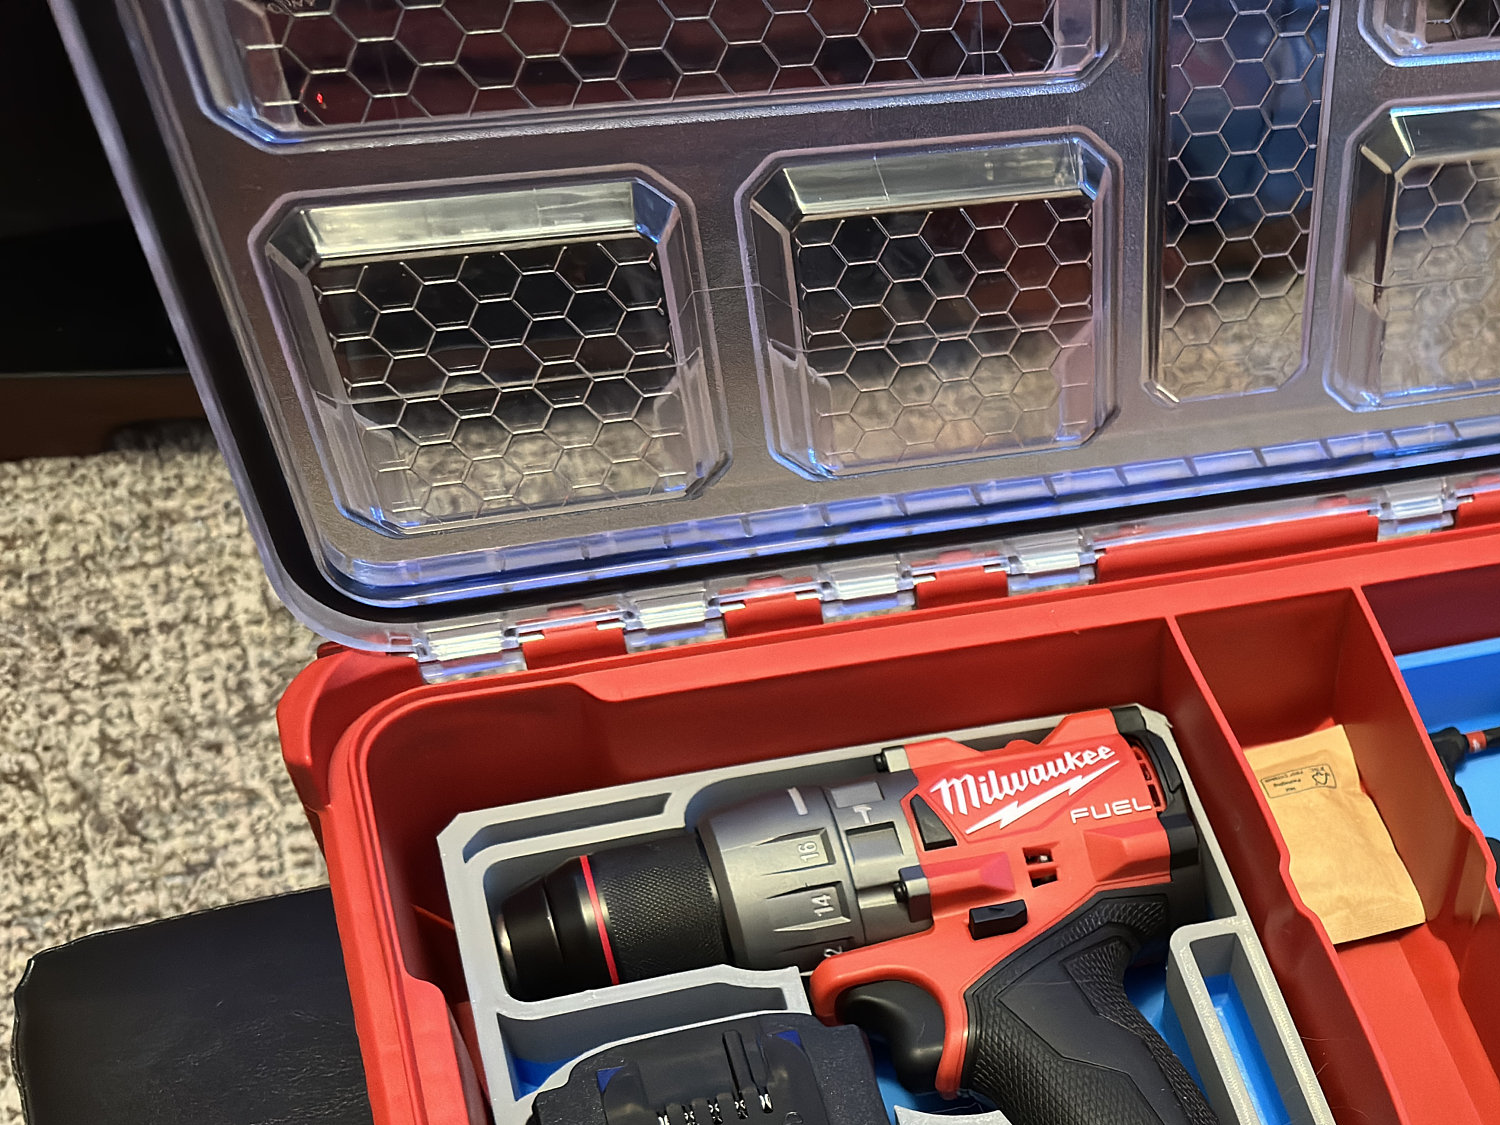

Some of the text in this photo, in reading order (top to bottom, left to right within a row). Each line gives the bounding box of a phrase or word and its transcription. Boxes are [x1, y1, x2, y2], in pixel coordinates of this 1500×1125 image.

[930, 745, 1115, 815] Milwaukee
[1070, 797, 1152, 824] FUEL
[798, 840, 819, 863] 16
[811, 894, 835, 917] 14
